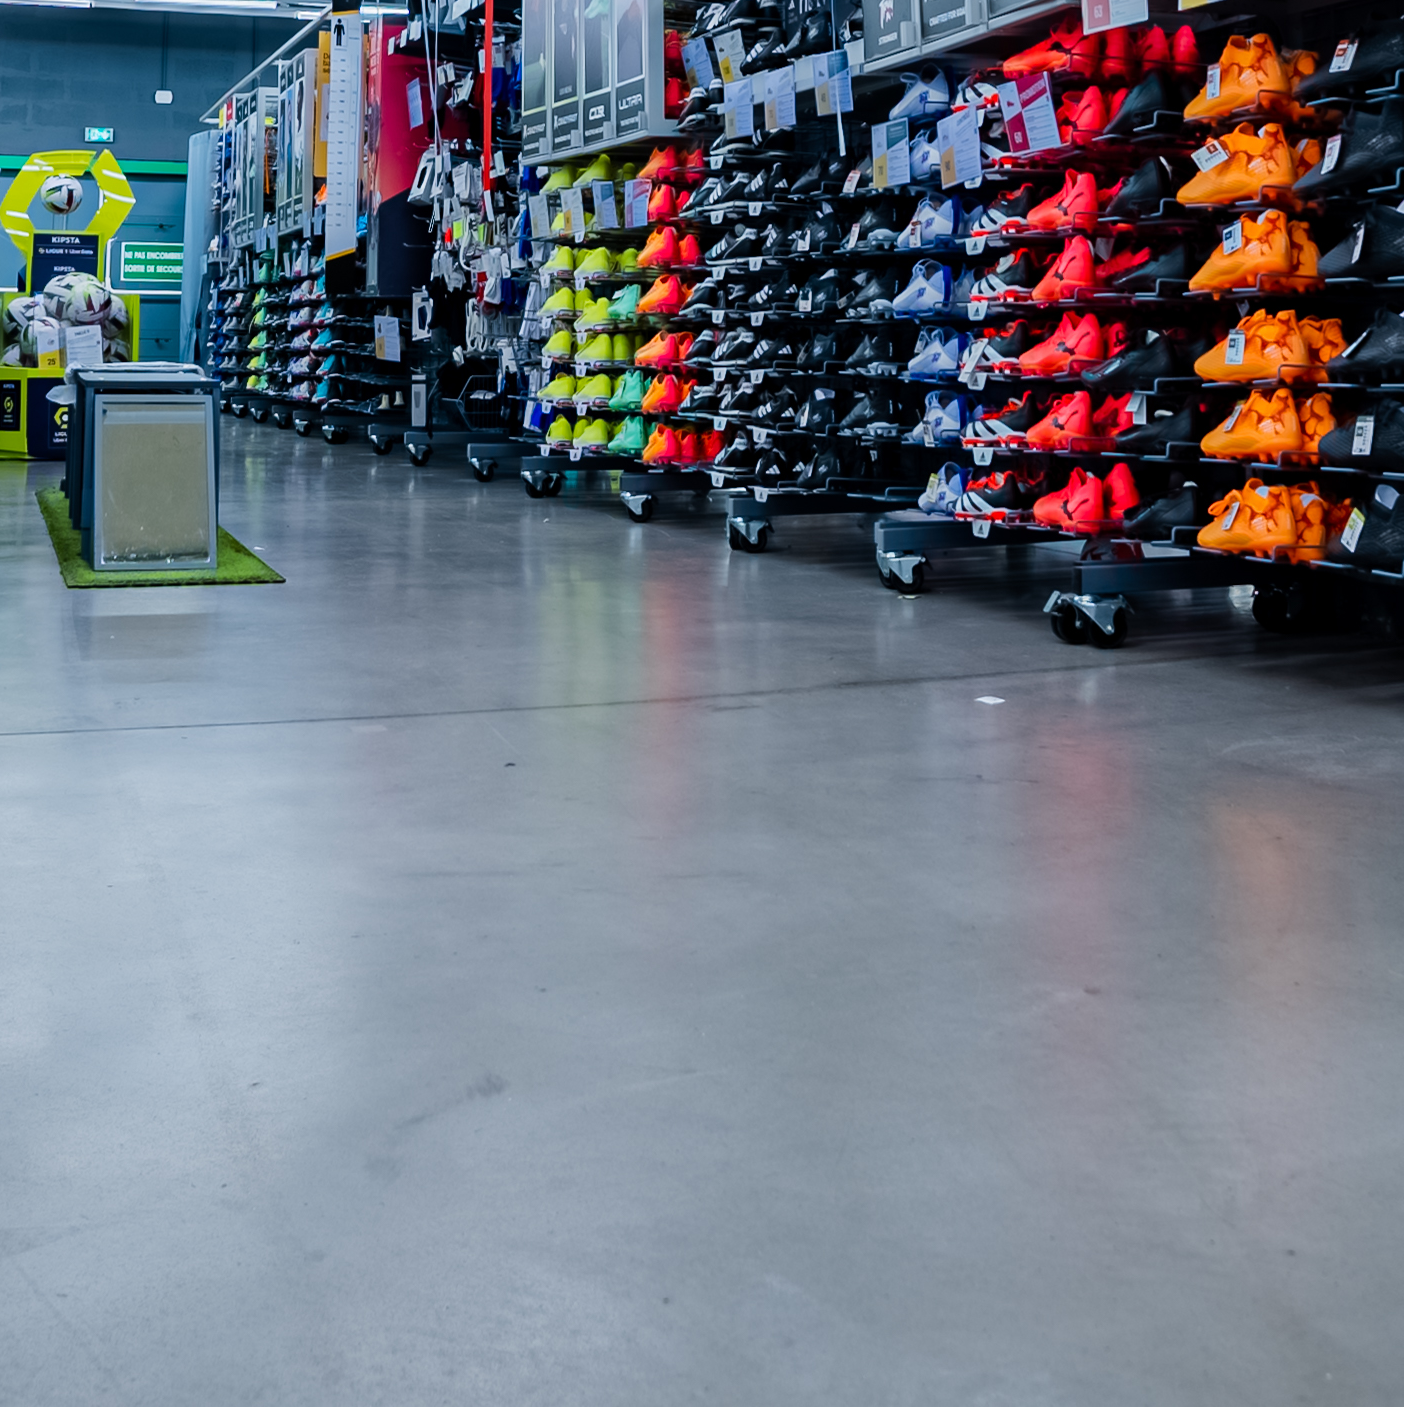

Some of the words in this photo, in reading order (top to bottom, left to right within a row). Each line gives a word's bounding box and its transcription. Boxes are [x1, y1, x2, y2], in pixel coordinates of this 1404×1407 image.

[51, 236, 81, 244] KIPSTA
[134, 251, 146, 259] PAS
[47, 358, 57, 366] 25
